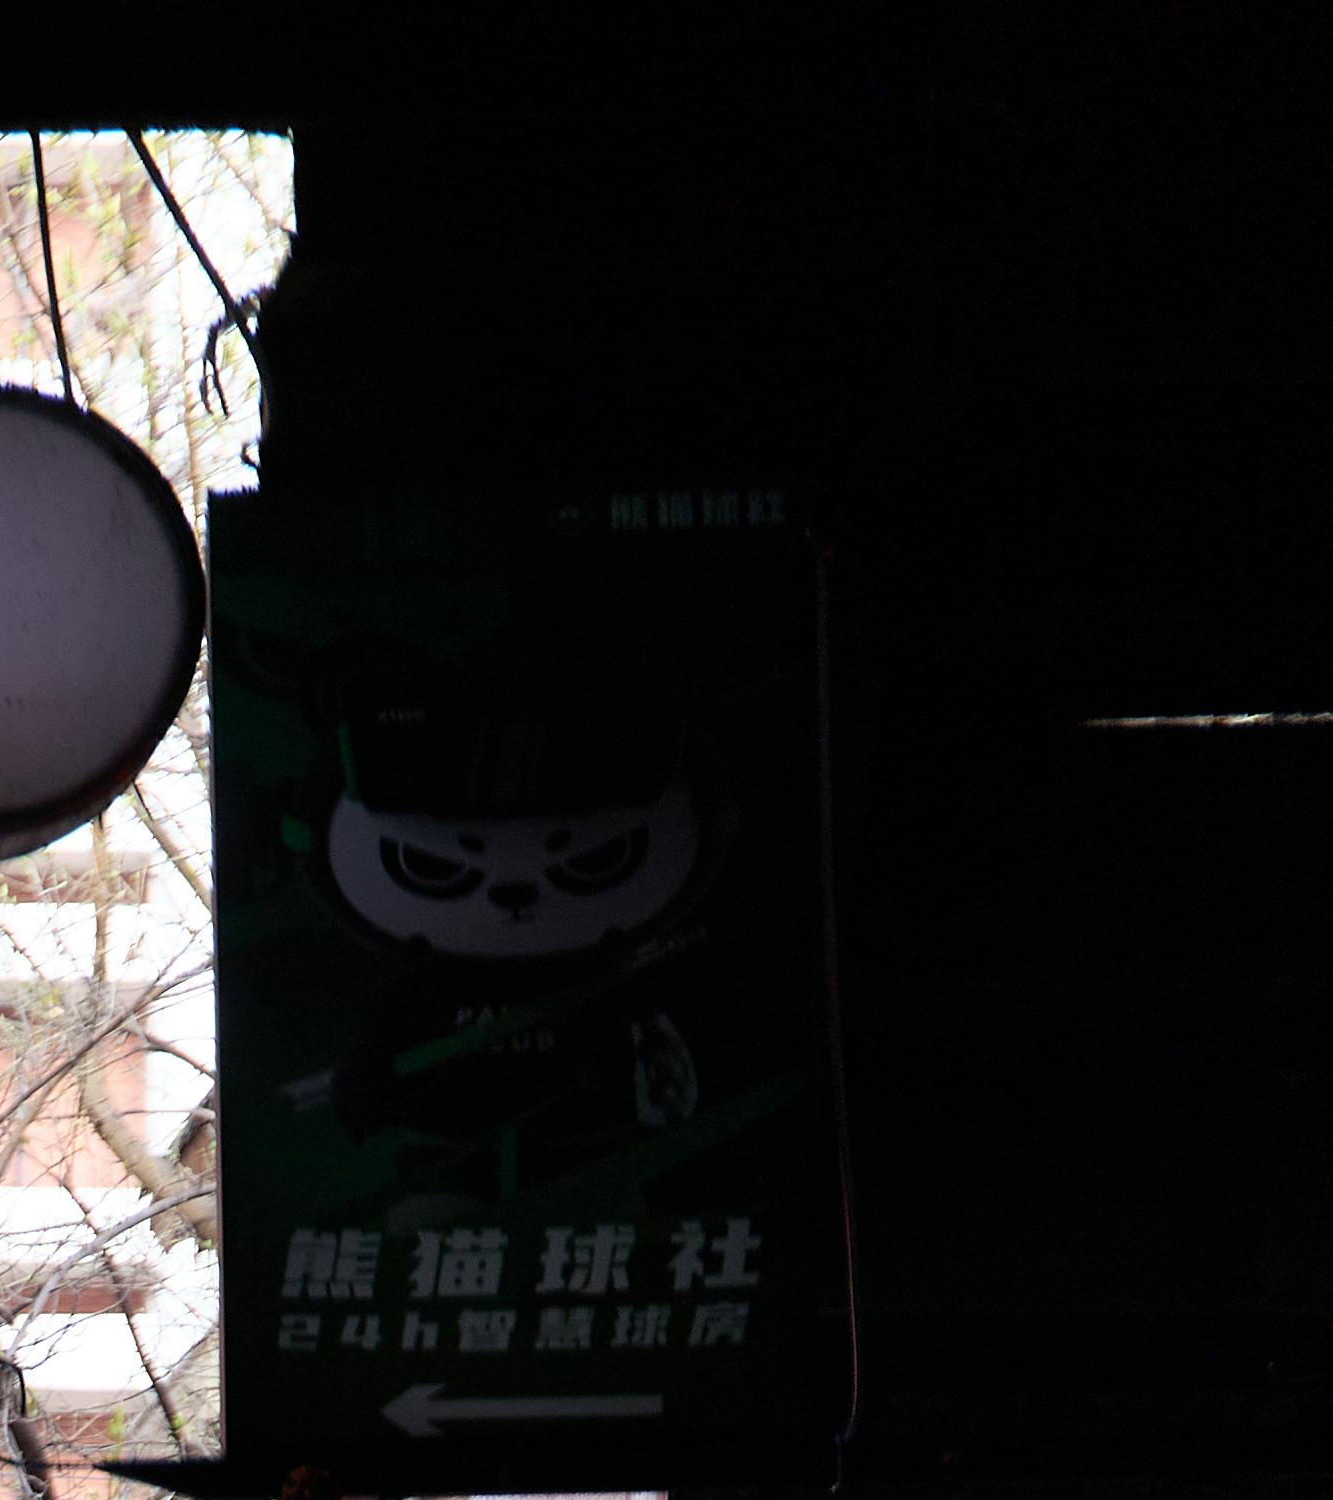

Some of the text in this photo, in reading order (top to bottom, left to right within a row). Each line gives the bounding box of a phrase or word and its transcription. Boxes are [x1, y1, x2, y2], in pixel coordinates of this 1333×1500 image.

[281, 1219, 763, 1302] 熊猫球社
[277, 1305, 751, 1353] 24h智慧球房
